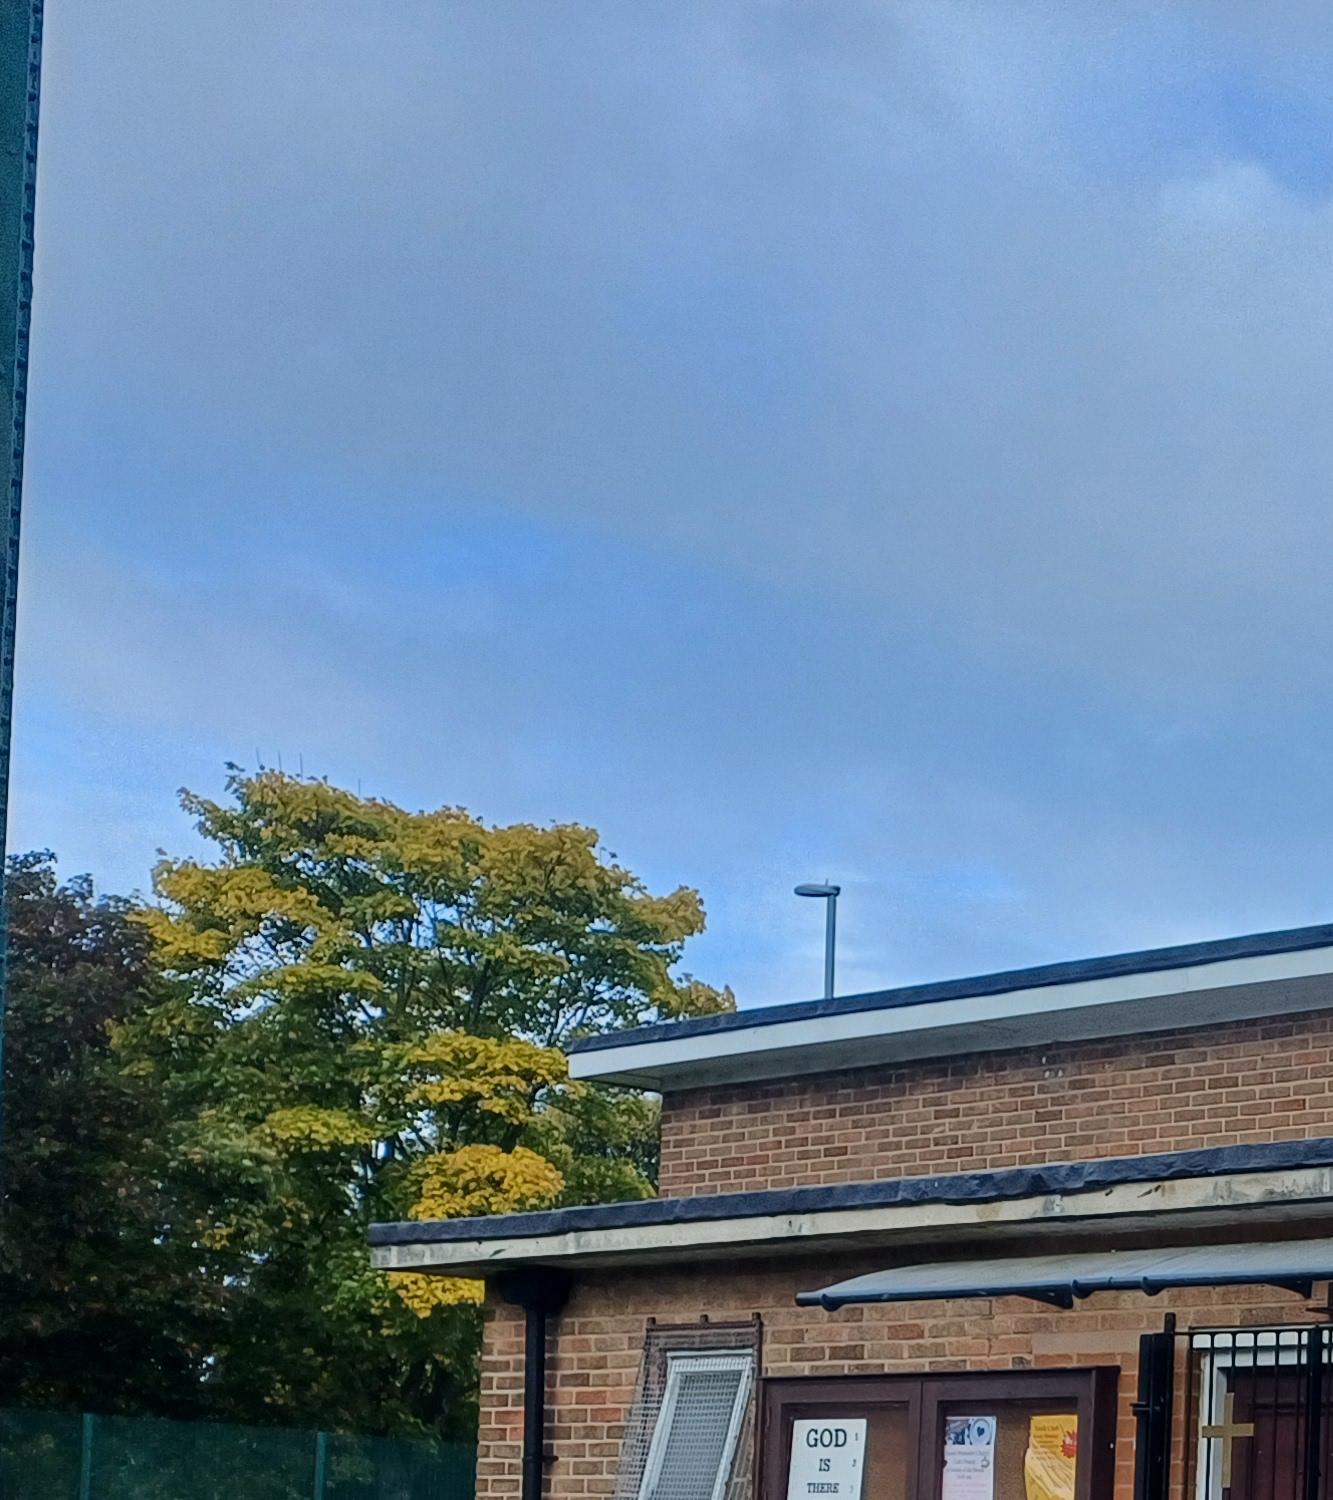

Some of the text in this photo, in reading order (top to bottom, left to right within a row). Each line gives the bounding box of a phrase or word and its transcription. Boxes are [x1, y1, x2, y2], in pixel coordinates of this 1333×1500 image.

[806, 1428, 847, 1448] GOD
[818, 1458, 831, 1472] IS
[807, 1482, 839, 1494] THERE
